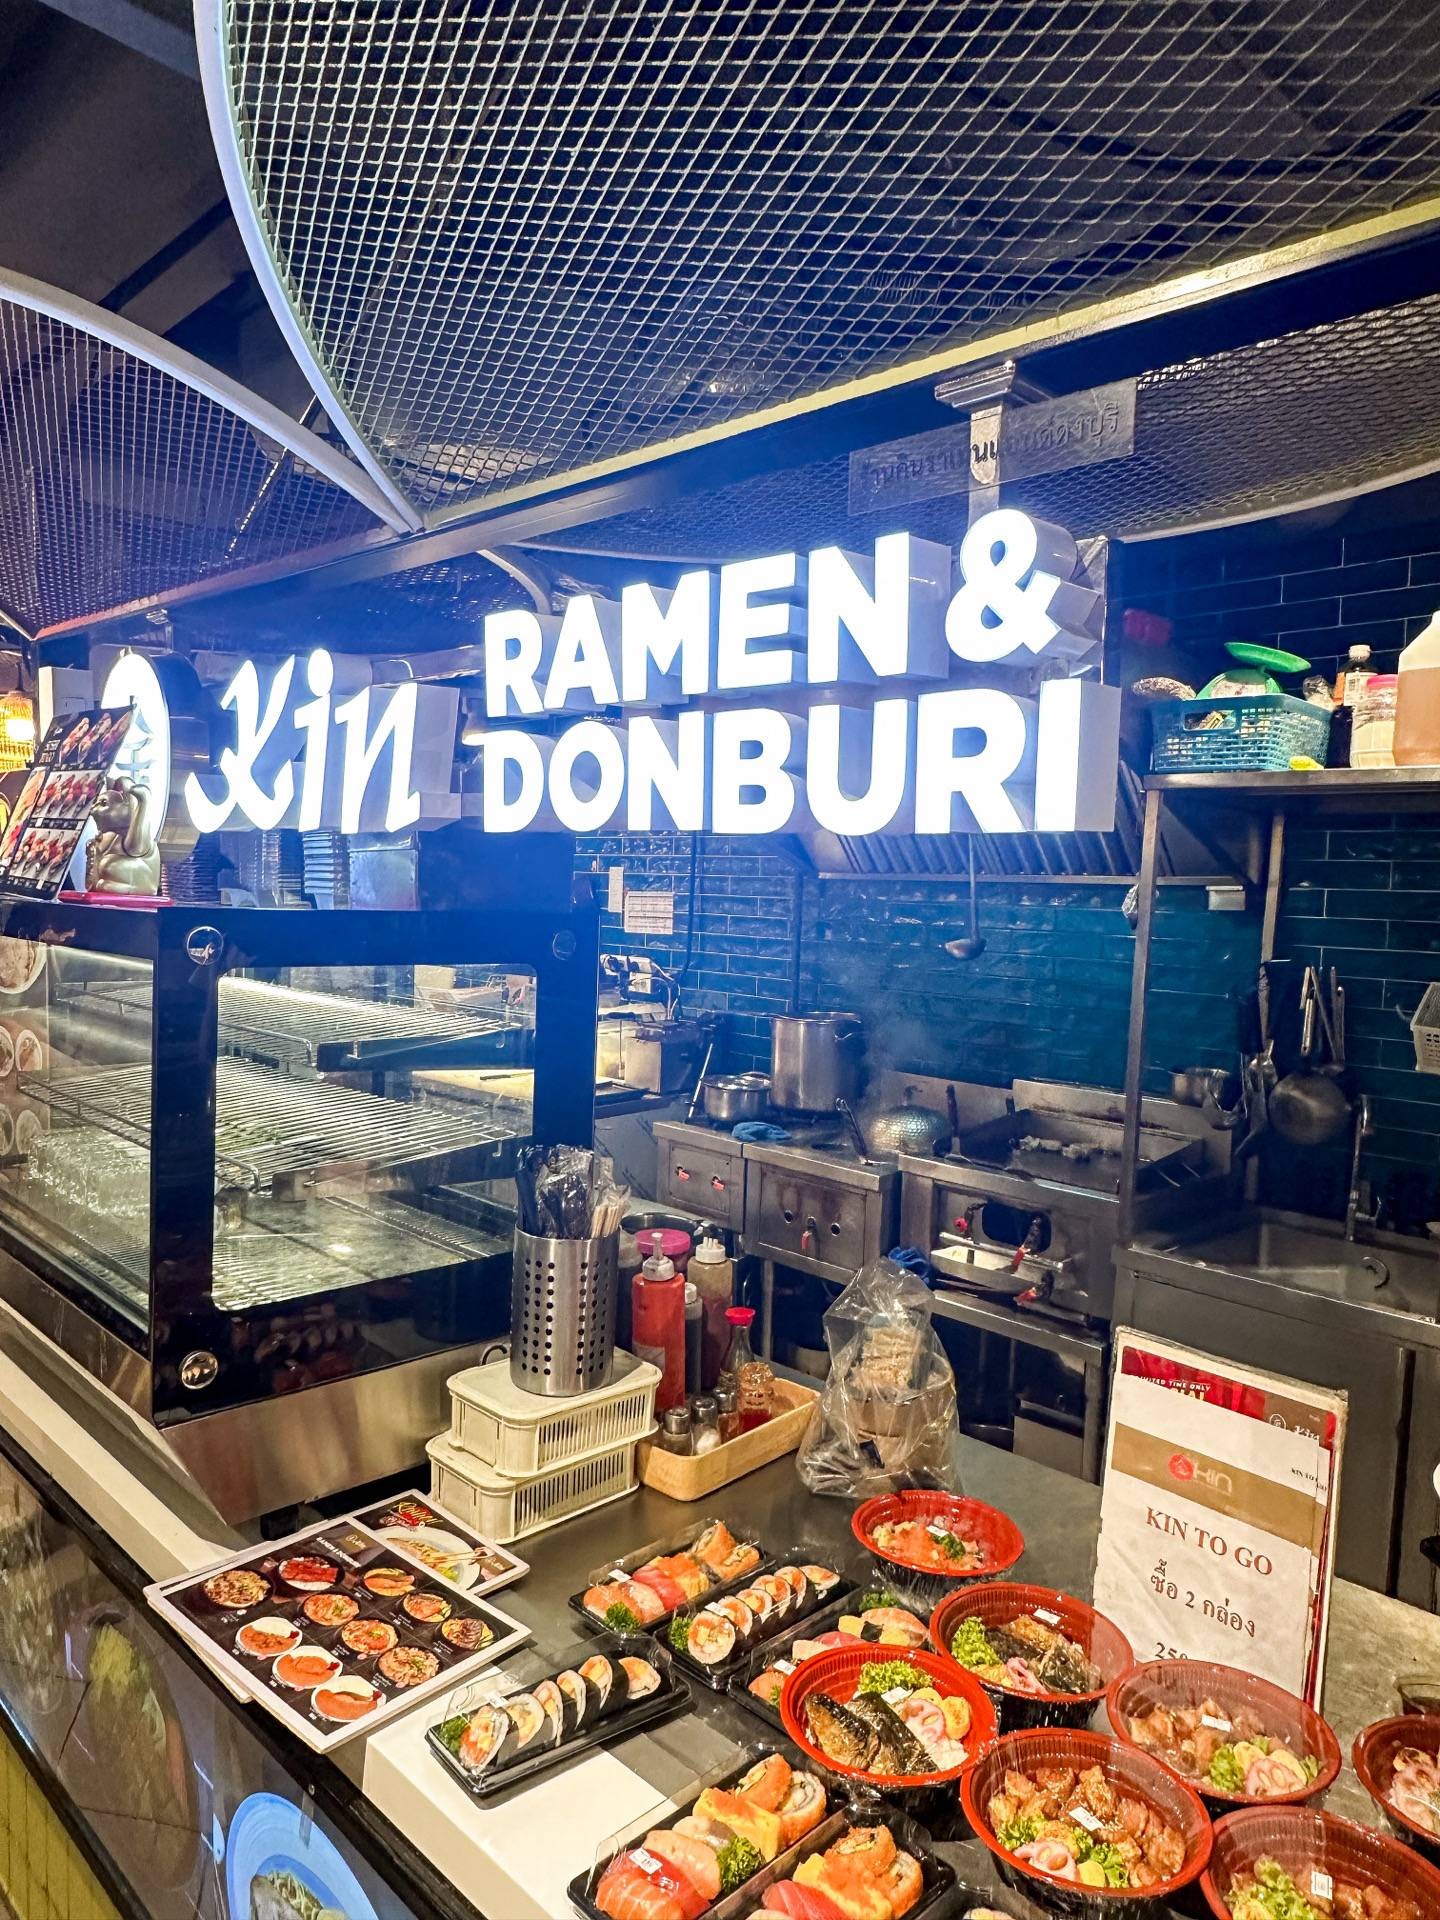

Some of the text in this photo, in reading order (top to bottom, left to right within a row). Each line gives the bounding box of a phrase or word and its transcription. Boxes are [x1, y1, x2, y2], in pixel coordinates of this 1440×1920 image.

[484, 509, 1061, 717] RAMEN &
[184, 649, 420, 834] Kin
[482, 678, 1082, 835] DONBURI
[1146, 1506, 1273, 1576] KIN TO GO
[1150, 1559, 1256, 1638] ซื้อ 2 กล่อง
